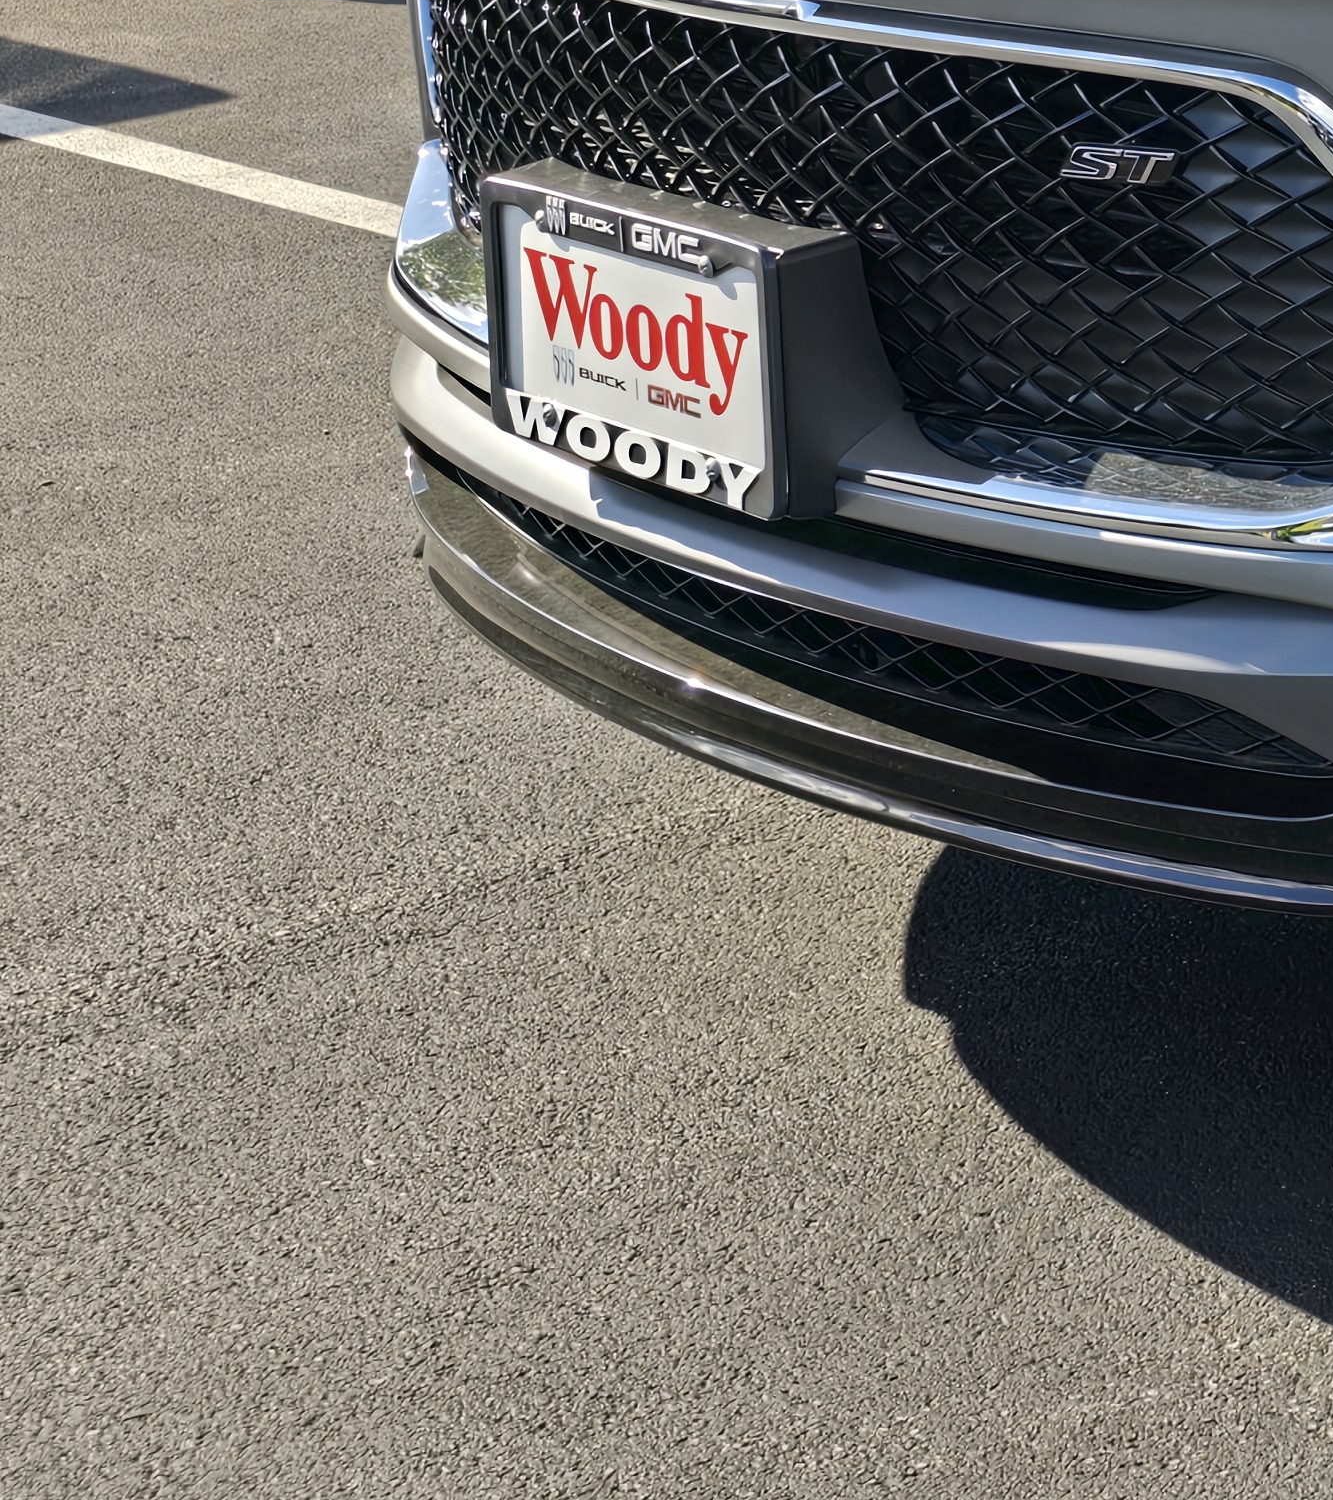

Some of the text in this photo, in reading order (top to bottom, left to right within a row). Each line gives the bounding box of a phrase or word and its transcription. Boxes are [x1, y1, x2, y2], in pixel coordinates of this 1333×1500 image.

[1060, 145, 1175, 185] ST
[569, 212, 704, 265] BUICK GMC
[523, 246, 749, 417] Woody
[578, 366, 702, 419] BUICK GMC
[506, 390, 761, 511] WOODY
